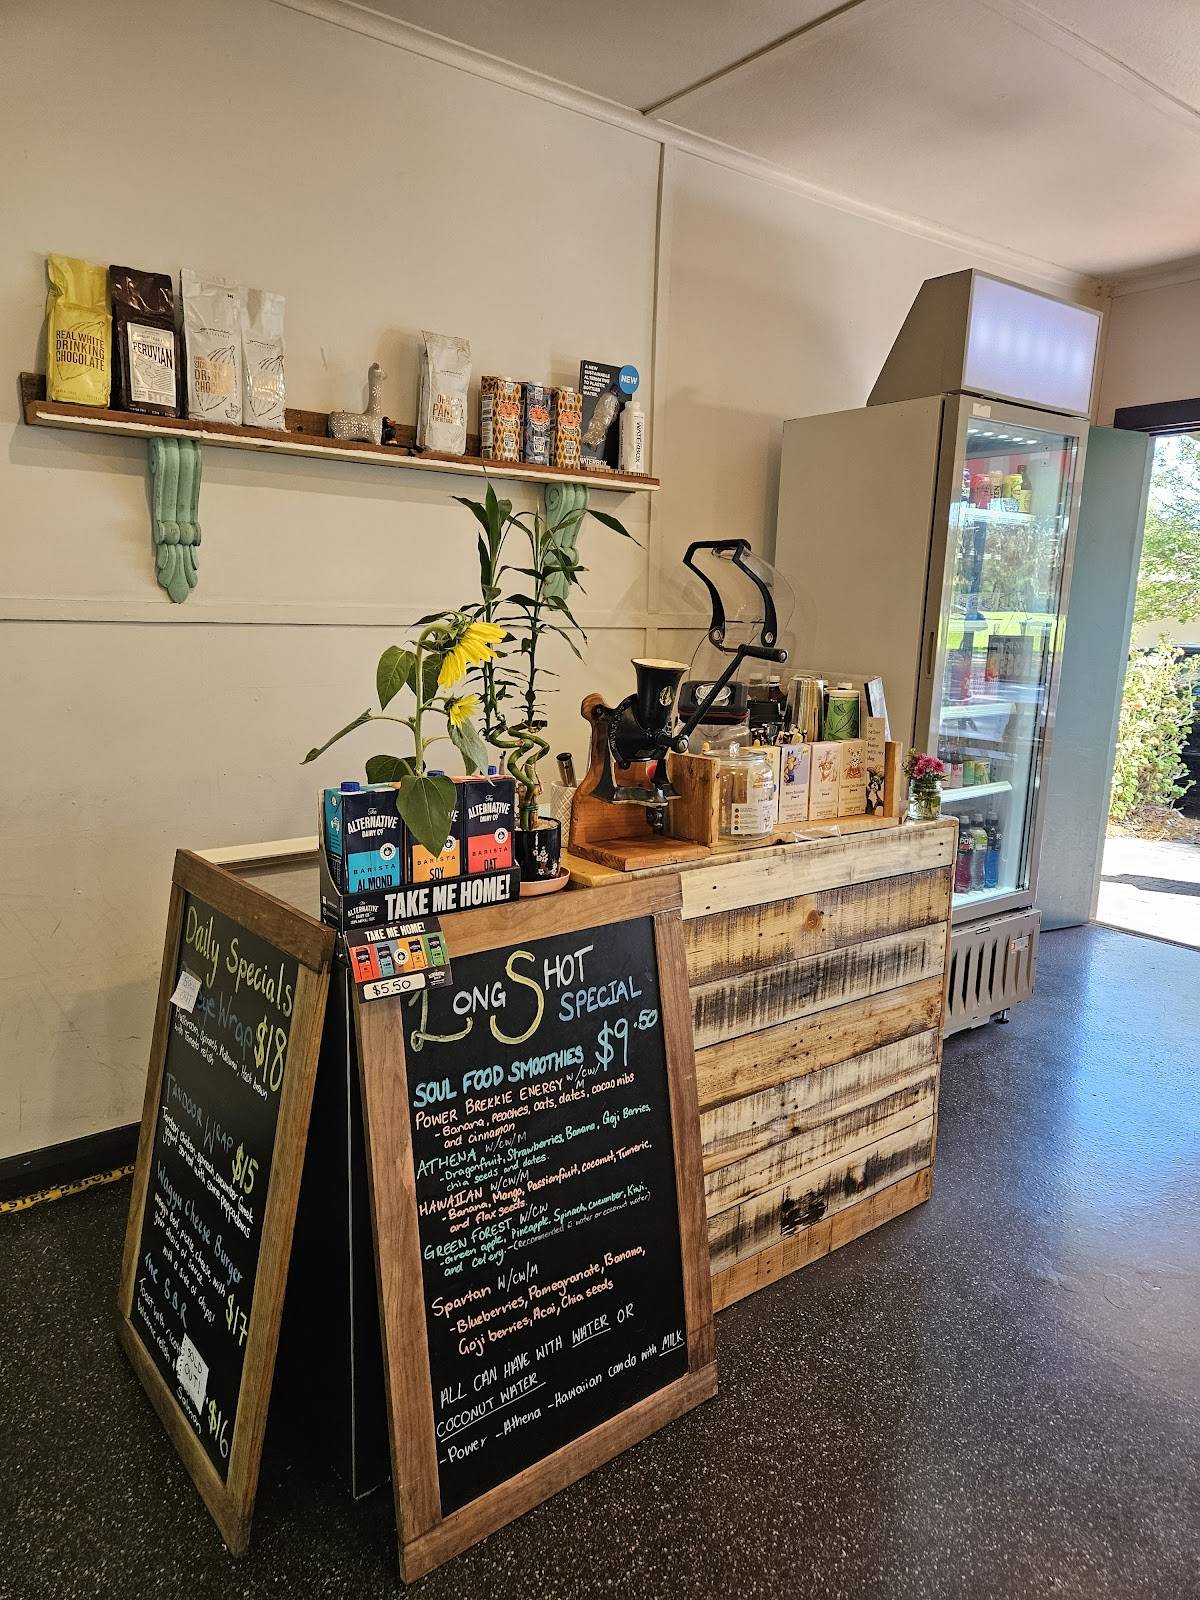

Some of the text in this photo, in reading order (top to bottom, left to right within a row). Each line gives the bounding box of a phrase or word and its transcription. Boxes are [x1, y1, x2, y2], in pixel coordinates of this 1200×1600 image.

[56, 329, 104, 349] REAL WHITE
[56, 339, 104, 360] DRINKING
[56, 350, 104, 372] CHOCOLATE
[132, 341, 173, 370] PERUVIAN
[620, 374, 638, 385] NEW
[347, 814, 399, 835] ALTERNATIVE
[467, 801, 511, 820] ALTERNATIVE
[472, 847, 508, 857] BARISTA
[483, 857, 497, 871] OAT
[353, 863, 396, 875] BARISTA
[357, 874, 393, 893] ALMOND
[429, 866, 445, 881] SOY
[384, 874, 512, 922] TAKE ME HOME!
[364, 922, 426, 942] TAKE ME HOME!
[185, 905, 220, 990] Daily
[226, 937, 293, 1018] Specials
[372, 979, 412, 997] $5.50
[490, 945, 594, 1045] SHOT
[558, 975, 643, 1023] SPECIAL
[218, 990, 254, 1061] Wrap
[253, 1013, 288, 1092] $18
[412, 1045, 585, 1108] SOUL FOOD SMOOTHIES
[591, 1079, 616, 1095] cacao
[616, 1071, 635, 1087] nibs
[415, 1077, 563, 1131] POWER BREKKIE ENERGY
[602, 1109, 621, 1129] Goji
[443, 1122, 517, 1149] and cinnamon
[231, 1141, 259, 1195] $15
[416, 1147, 478, 1180] ATHENA
[446, 1180, 470, 1192] chia
[474, 1168, 499, 1184] seeds
[503, 1159, 519, 1174] and
[418, 1186, 484, 1218] HAWAIIAN
[157, 1159, 244, 1287] Wagyu Cheese Burger
[449, 1216, 470, 1233] and
[475, 1209, 497, 1225] flax
[423, 1237, 467, 1261] GREEN
[470, 1217, 513, 1244] FOREST
[144, 1252, 159, 1285] The
[443, 1261, 464, 1277] and
[212, 1276, 226, 1298] with
[431, 1284, 492, 1319] Spartan
[225, 1293, 249, 1347] $17
[458, 1332, 485, 1357] Goji
[560, 1289, 585, 1311] Chia
[585, 1277, 614, 1299] seeds
[439, 1302, 635, 1410] ALL CAN HAVE WITH WATER OR
[641, 1342, 658, 1362] with
[661, 1330, 685, 1352] MILK
[176, 1385, 202, 1435] Salmon
[436, 1371, 540, 1439] COCONUT WATER
[207, 1398, 229, 1459] $16
